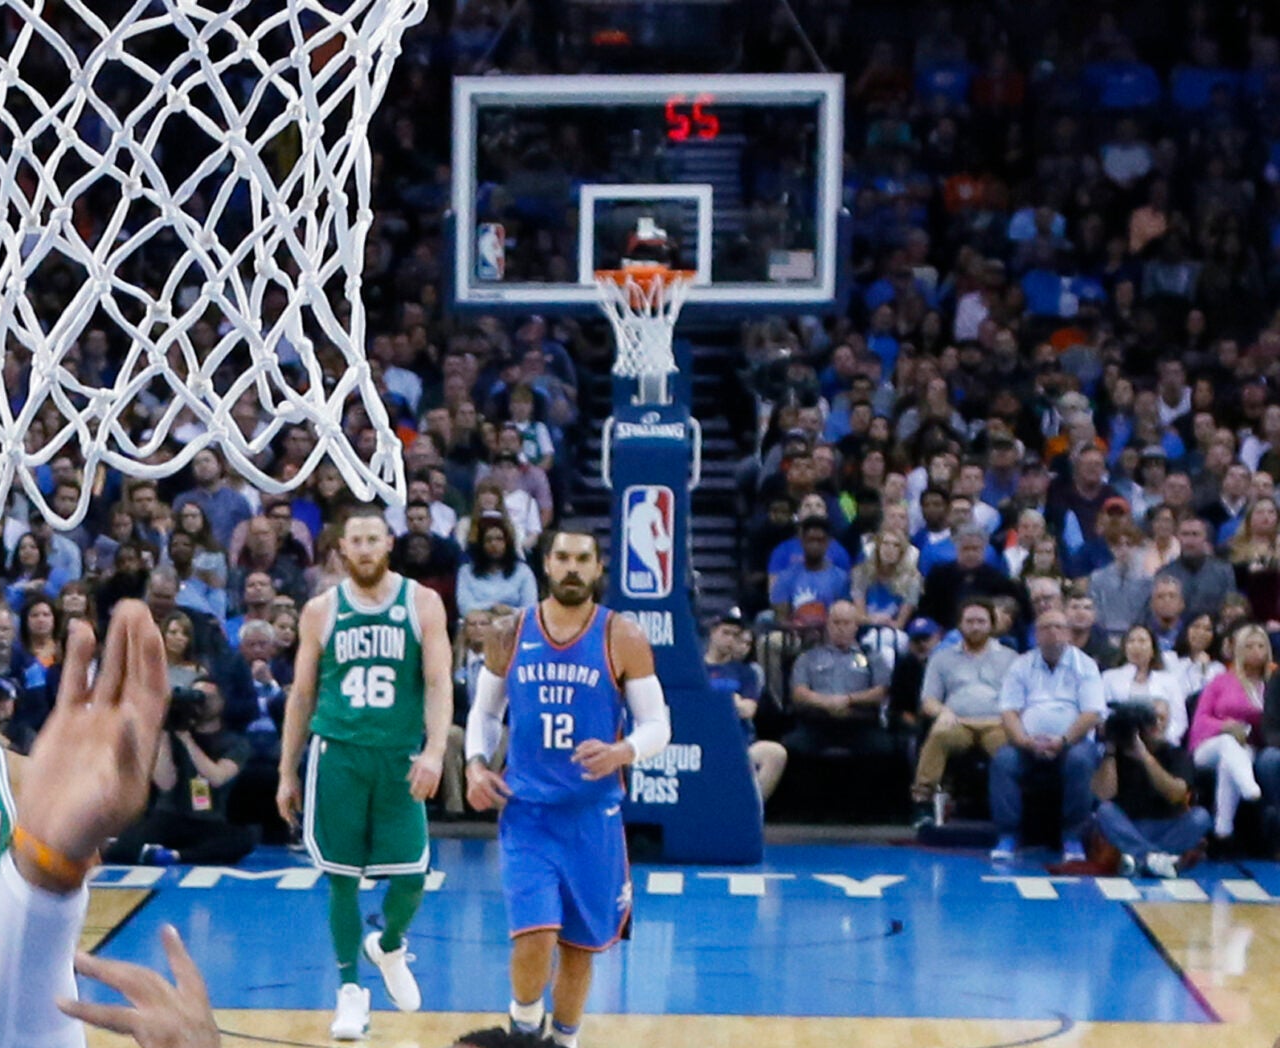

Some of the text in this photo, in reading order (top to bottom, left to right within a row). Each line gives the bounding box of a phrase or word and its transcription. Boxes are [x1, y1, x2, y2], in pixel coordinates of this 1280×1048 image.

[664, 94, 720, 142] 55
[616, 421, 685, 440] SPALDING
[334, 624, 406, 664] BOSTON
[341, 665, 397, 708] 46
[517, 662, 600, 687] OKLAHOMA
[539, 685, 575, 704] CITY
[540, 712, 574, 749] 12
[631, 769, 680, 803] Pass
